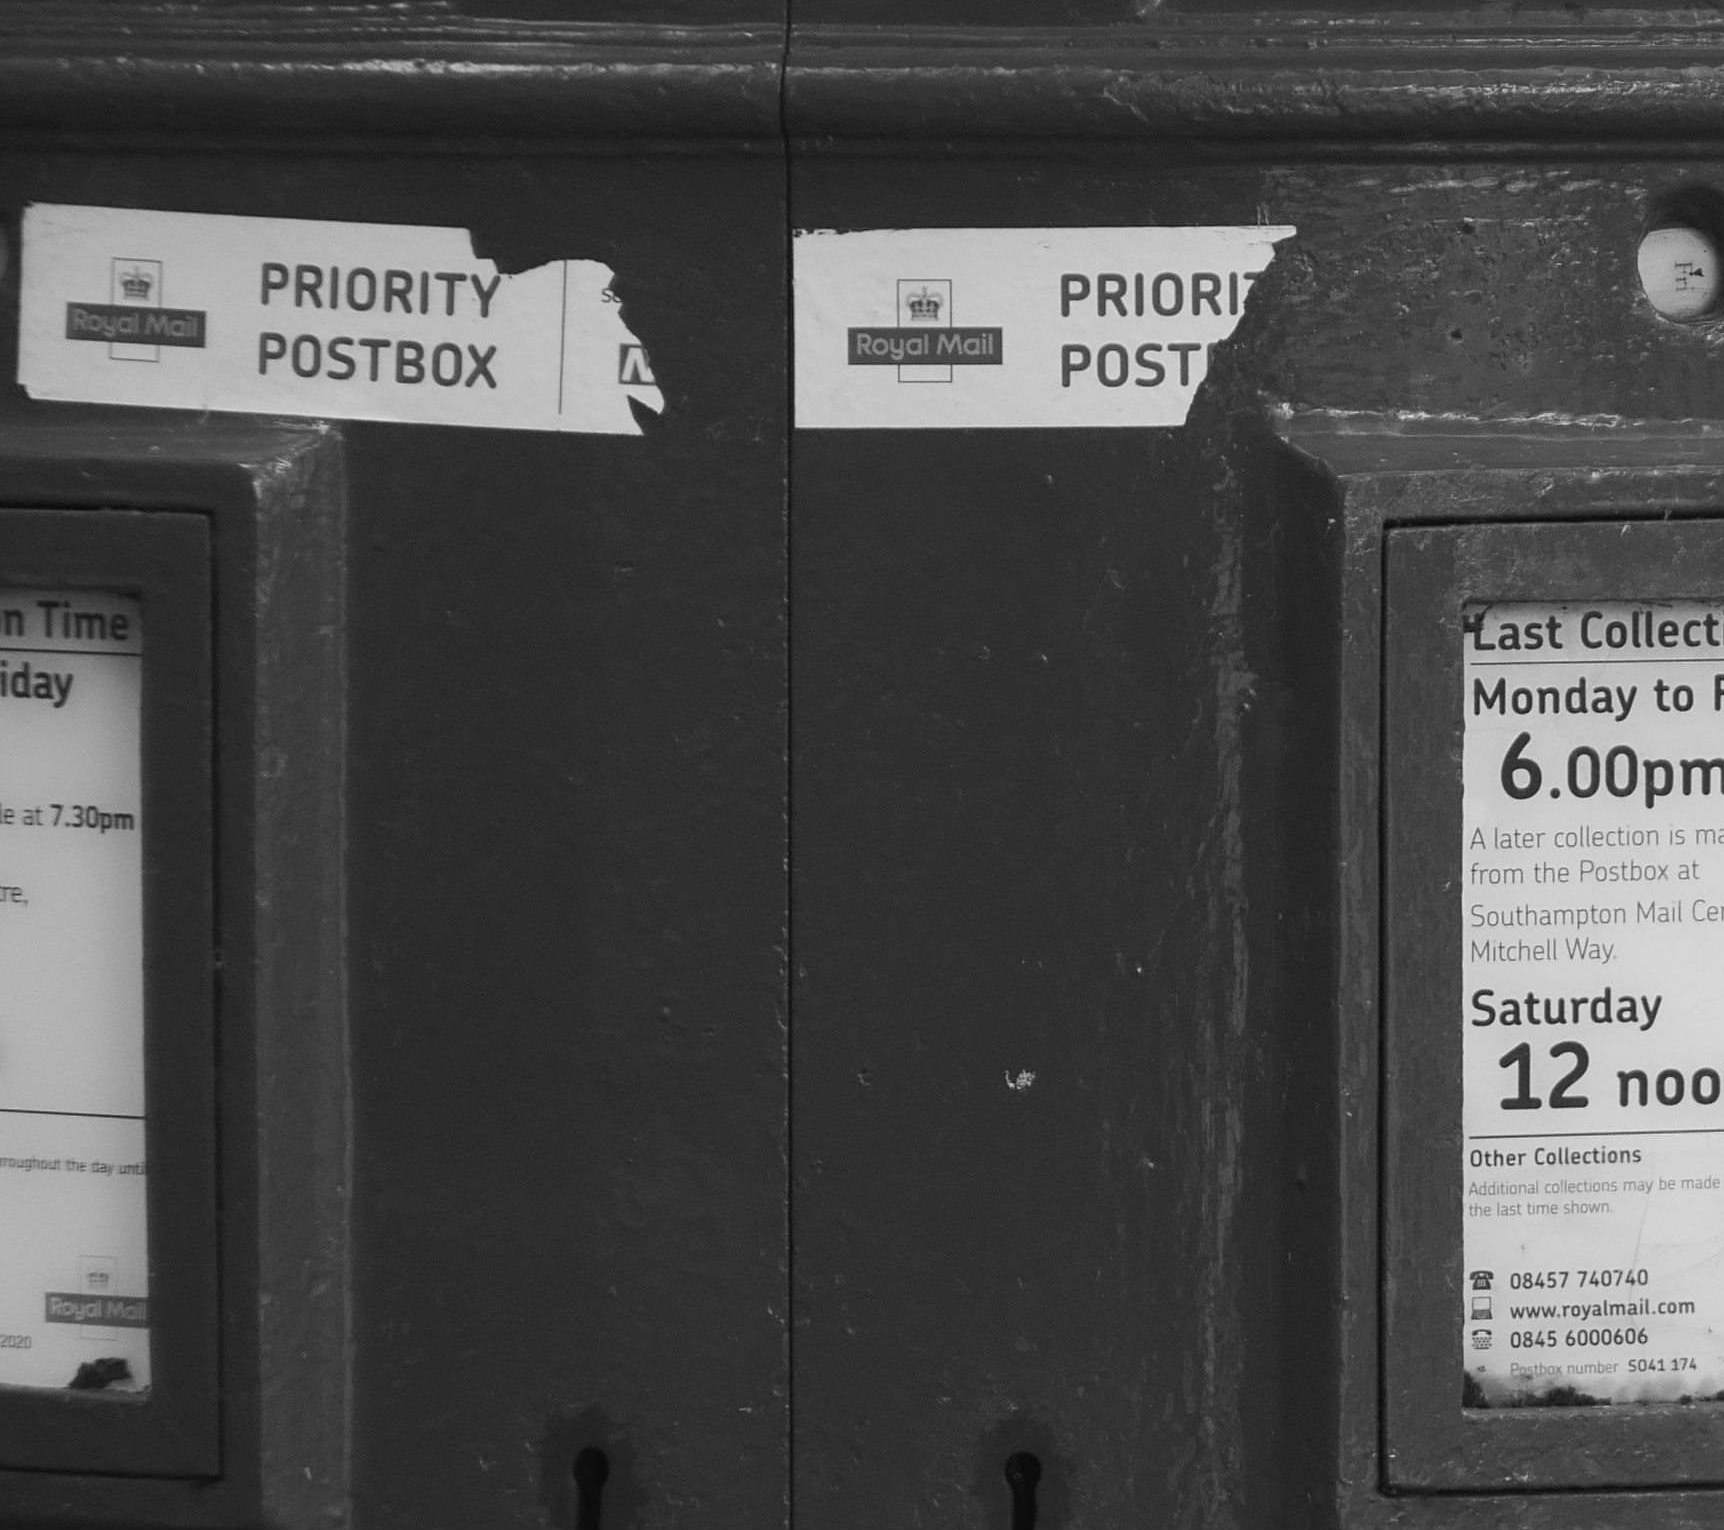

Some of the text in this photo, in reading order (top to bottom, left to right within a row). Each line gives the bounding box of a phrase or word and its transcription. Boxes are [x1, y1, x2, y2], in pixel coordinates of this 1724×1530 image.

[259, 262, 500, 319] PRIORITY
[72, 308, 198, 339] Royal Mail
[856, 333, 993, 360] Royal Mail
[258, 332, 498, 389] POSTBOX
[1061, 342, 1219, 388] POST
[37, 599, 128, 640] Time
[1472, 615, 1563, 651] Last
[1473, 676, 1637, 722] Monday
[1654, 680, 1694, 712] to
[23, 806, 43, 826] at
[49, 803, 136, 833] 7.30pm
[1470, 827, 1486, 850] A
[1493, 826, 1546, 849] later
[1554, 824, 1659, 849] collection
[1670, 824, 1685, 846] is
[1470, 859, 1700, 885] from the Postbox at
[1470, 903, 1626, 930] Southampton
[1636, 901, 1682, 924] Mail
[1470, 938, 1618, 964] Mitchell Way.
[1471, 986, 1662, 1032] Saturday
[1498, 1041, 1590, 1111] 12
[1469, 1146, 1642, 1168] Other Collections
[1468, 1178, 1539, 1196] Additional
[1544, 1177, 1618, 1195] collections
[1623, 1178, 1654, 1197] may
[1659, 1176, 1676, 1191] be
[1681, 1174, 1721, 1191] made
[1468, 1198, 1613, 1217] the last time shown.
[1510, 1269, 1649, 1290] 08457 740740
[50, 1295, 102, 1320] Royal
[1510, 1298, 1695, 1321] www.royalmail.com
[1510, 1328, 1649, 1349] 0845 6000606
[1510, 1362, 1563, 1375] Postbox
[1567, 1361, 1619, 1375] number
[1670, 1357, 1697, 1372] 174
